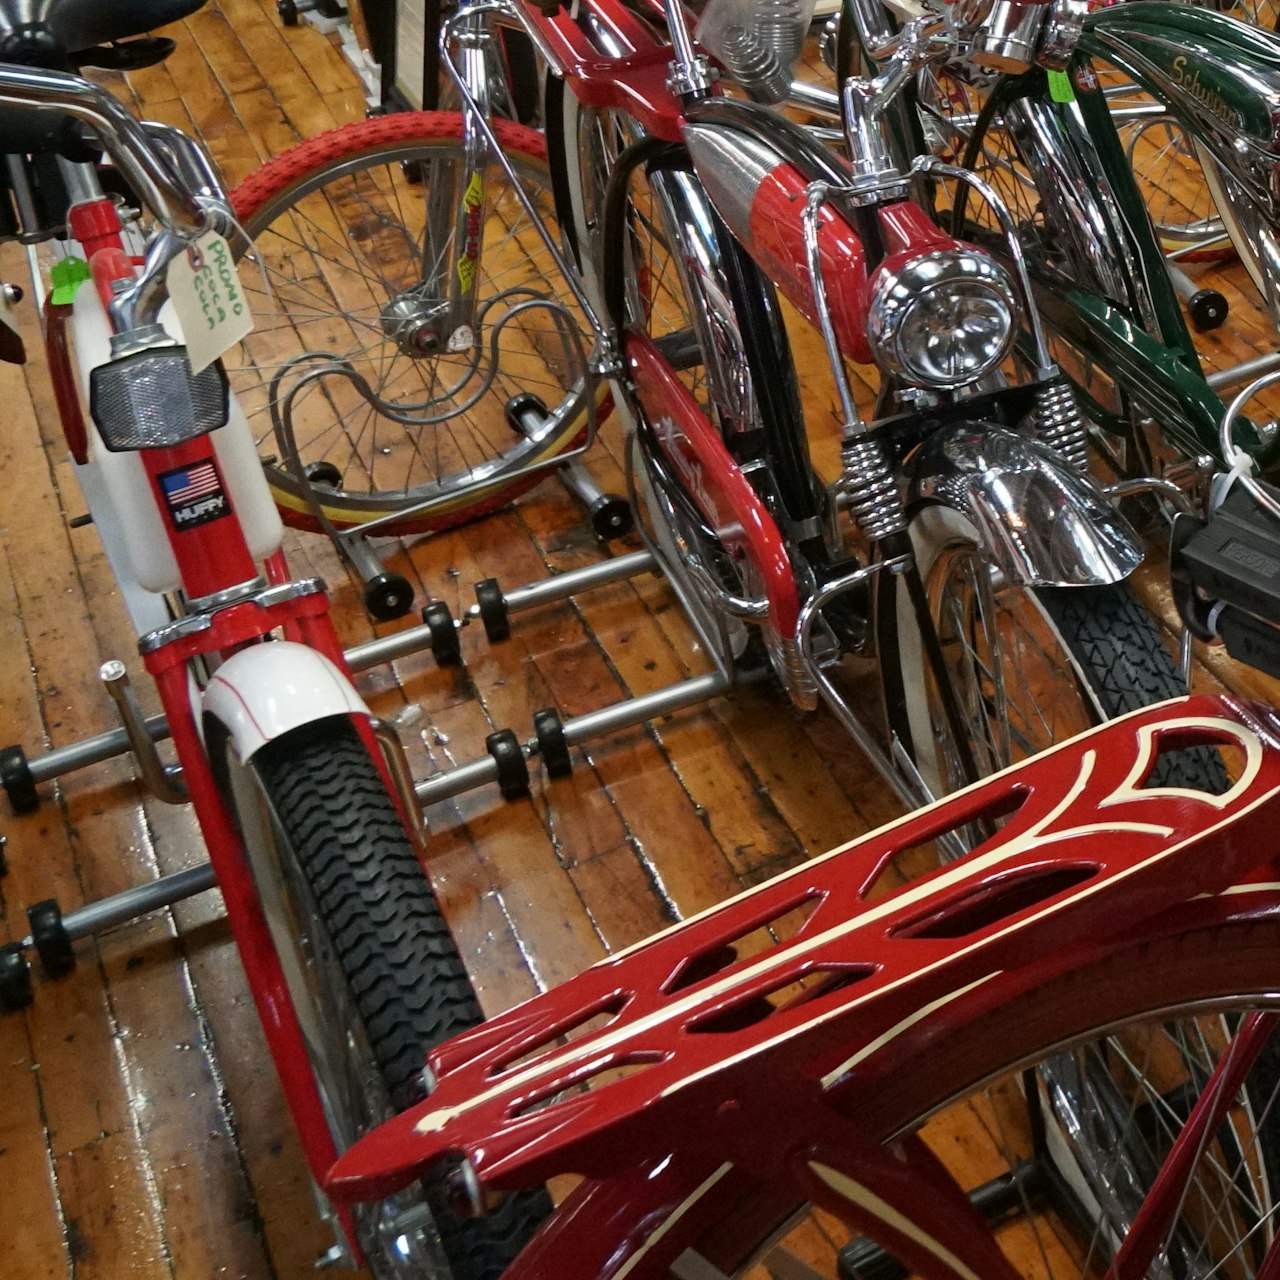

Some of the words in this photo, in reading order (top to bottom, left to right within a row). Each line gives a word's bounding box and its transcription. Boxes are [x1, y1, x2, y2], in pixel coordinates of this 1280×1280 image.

[1172, 55, 1237, 130] Schwinn
[207, 240, 244, 317] PROMO
[174, 495, 224, 524] HUFFY
